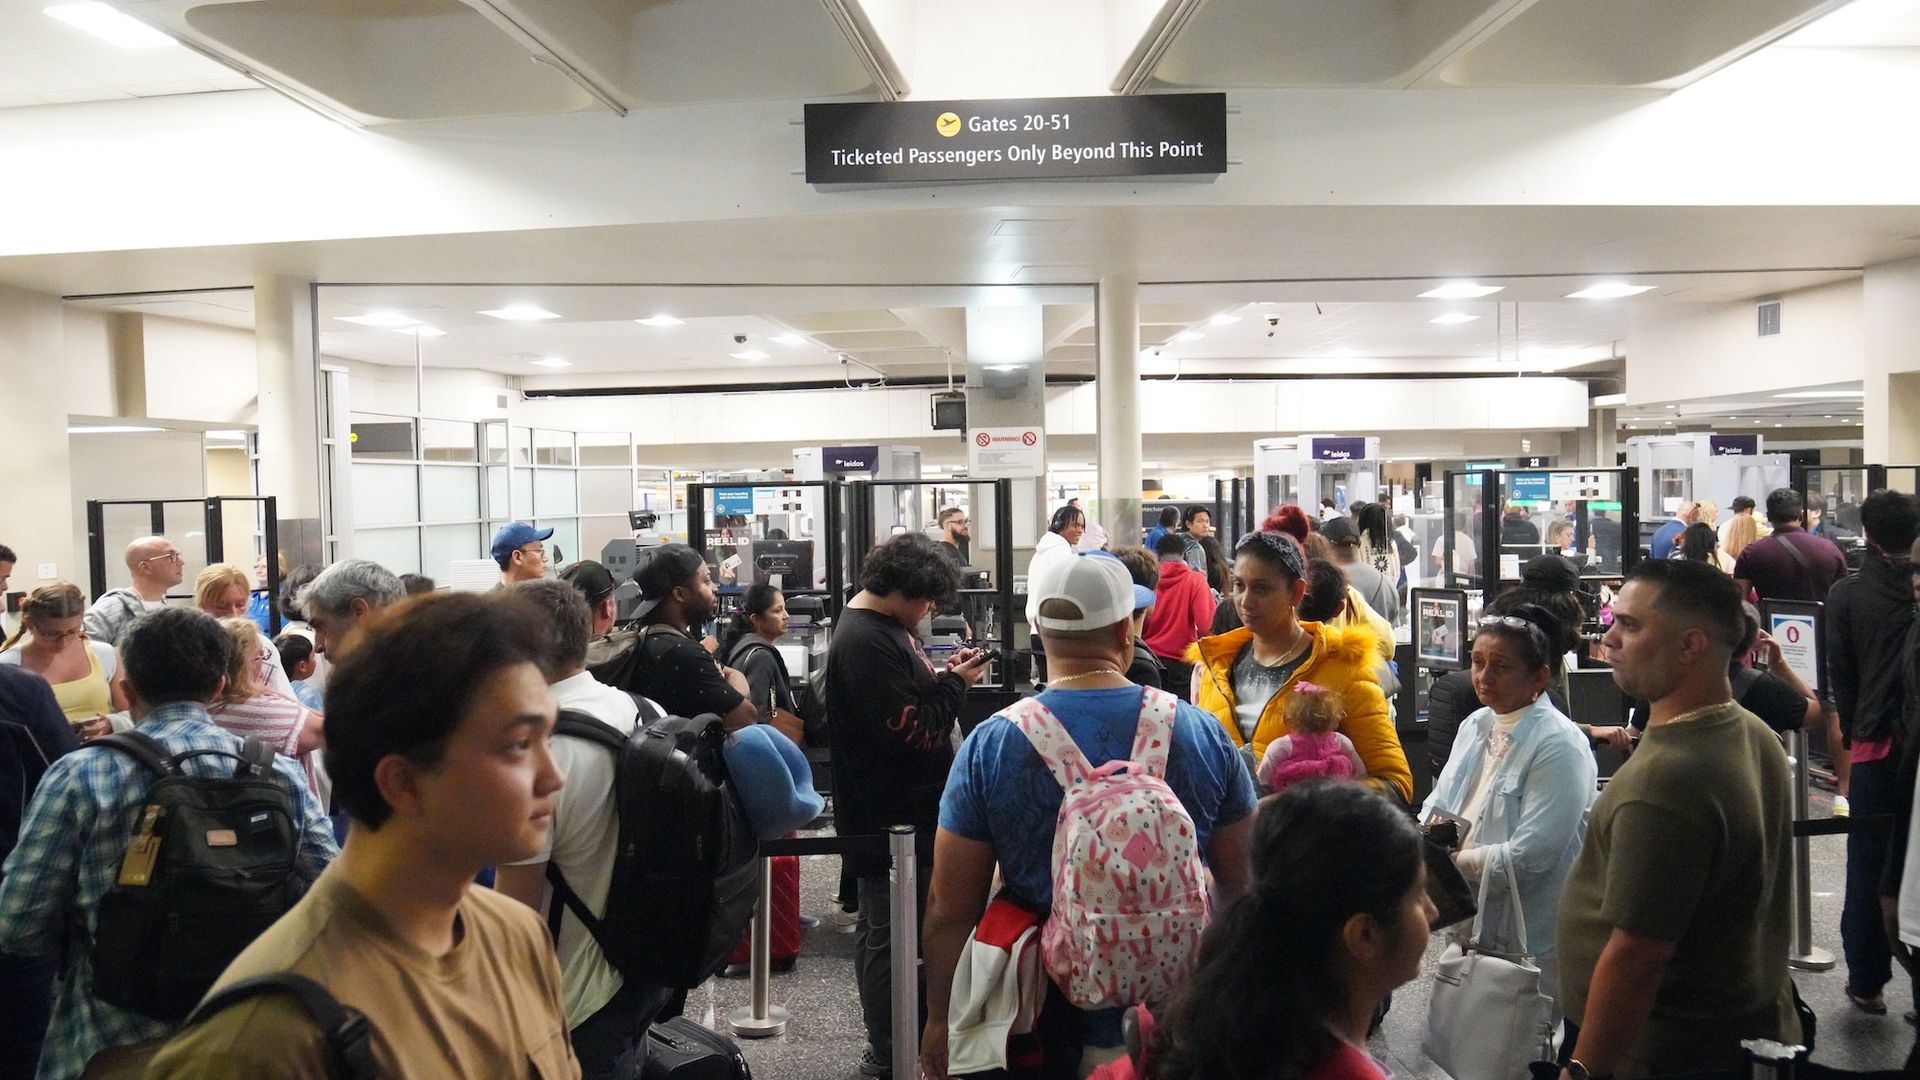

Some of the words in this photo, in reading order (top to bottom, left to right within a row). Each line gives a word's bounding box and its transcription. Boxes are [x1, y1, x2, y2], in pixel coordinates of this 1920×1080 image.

[968, 116, 1017, 132] Gates
[1023, 114, 1070, 131] 20-51
[831, 147, 903, 166] Ticketed
[909, 148, 1002, 167] Passengers
[1007, 144, 1046, 165] Only
[1052, 142, 1115, 164] Beyond
[1119, 141, 1154, 158] This
[1159, 140, 1204, 157] Point
[706, 538, 736, 546] REAL
[738, 537, 750, 546] ID
[1422, 608, 1445, 617] REAL
